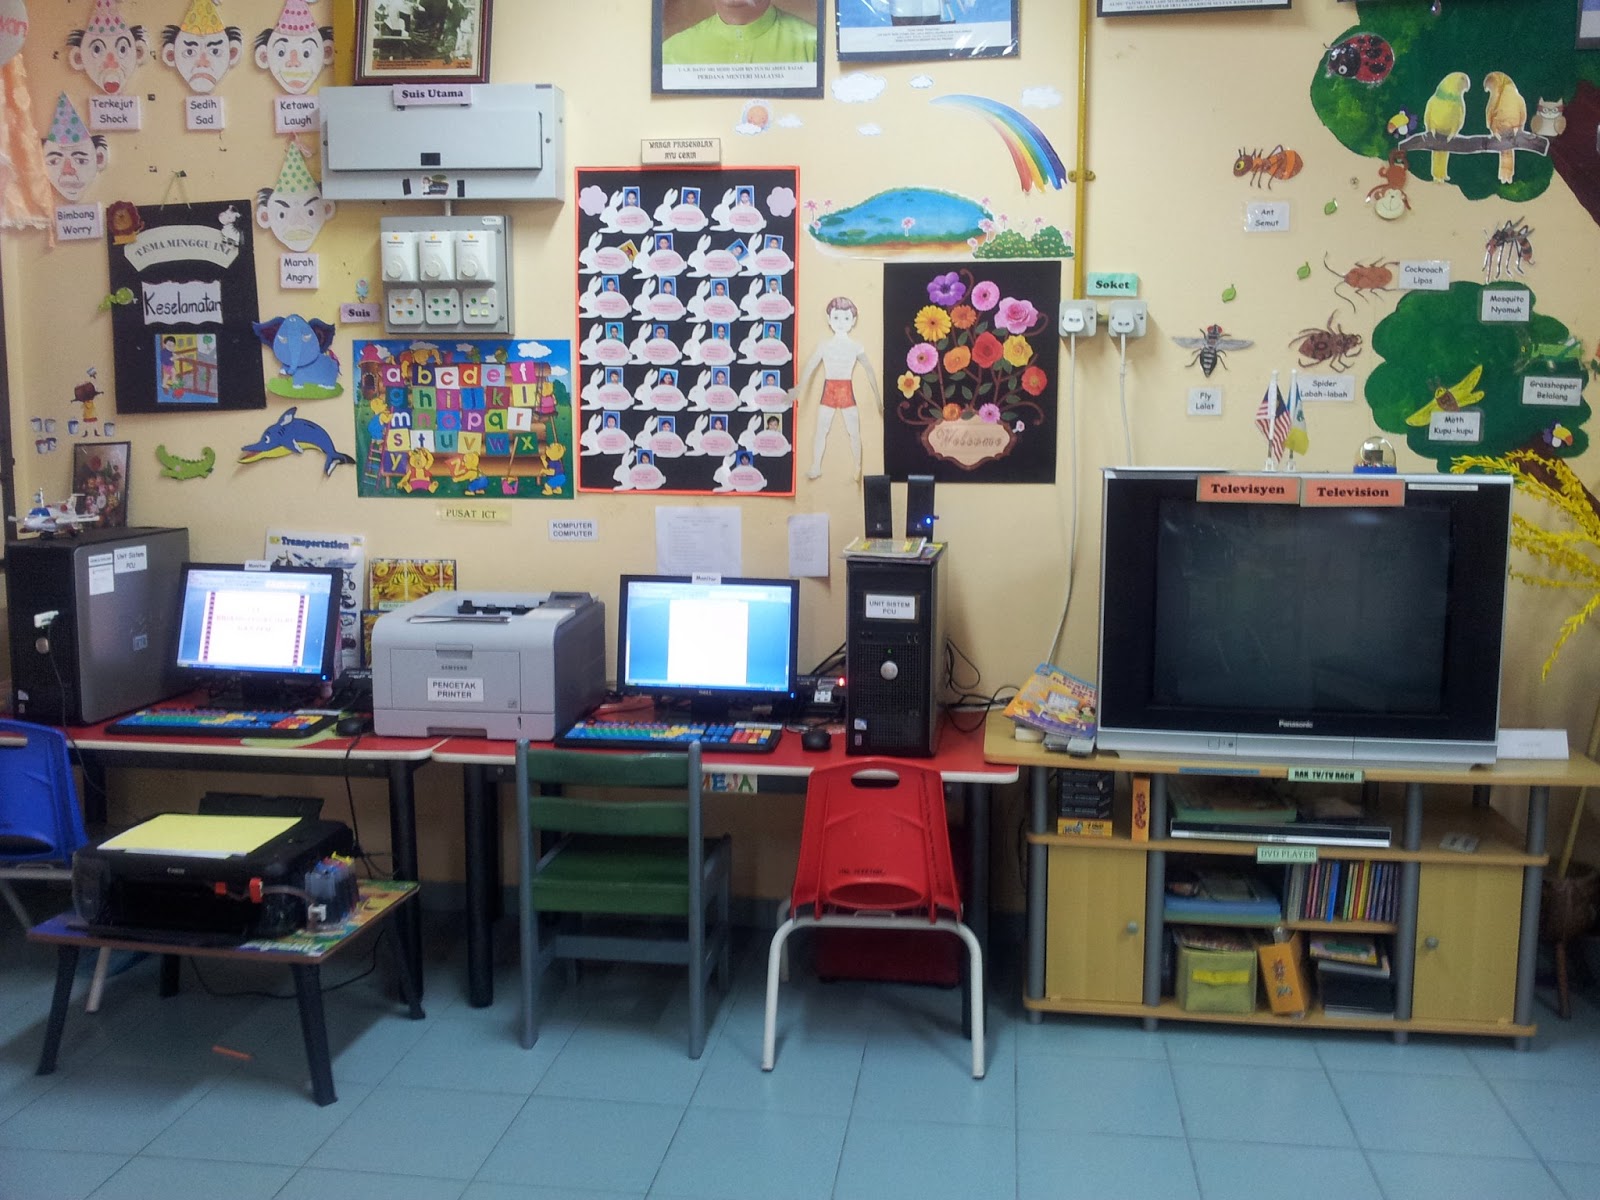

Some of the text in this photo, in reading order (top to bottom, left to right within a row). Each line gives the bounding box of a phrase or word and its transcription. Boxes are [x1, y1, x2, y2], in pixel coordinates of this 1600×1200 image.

[402, 89, 463, 98] Suis Utama
[92, 99, 133, 110] Terkejut
[190, 100, 217, 110] Sedih
[280, 101, 315, 110] Ketawa
[100, 113, 128, 123] Shock
[195, 115, 214, 124] Sad
[284, 115, 312, 127] Laugh
[57, 210, 95, 221] Bimbang
[62, 225, 92, 235] Worry
[135, 239, 231, 256] TEMA MINGGU INI
[283, 258, 314, 267] Marah
[1404, 265, 1443, 274] Cockroach
[286, 273, 313, 284] Angry
[1413, 277, 1433, 285] Lipas
[1095, 280, 1130, 290] Soket
[144, 291, 223, 316] Keselamatan
[1489, 295, 1525, 304] Mosquito
[348, 308, 371, 317] Suis
[1490, 306, 1522, 315] Nyamuk
[1312, 379, 1337, 388] Spider
[1529, 380, 1578, 391] Grasshopper
[1200, 392, 1212, 401] Fly
[1536, 391, 1568, 402] Belalang
[1444, 416, 1464, 424] Moth
[1211, 482, 1285, 496] Televisyen
[1317, 486, 1389, 498] Television
[446, 509, 497, 519] PUSAT ICT
[281, 536, 349, 549] Transportation
[869, 600, 886, 608] UNIT
[432, 681, 476, 690] PENCETAK
[1278, 719, 1314, 729] Panasonic
[1294, 770, 1309, 778] RAK
[1335, 772, 1355, 780] RACK
[1260, 849, 1315, 860] DVD PLAYER
